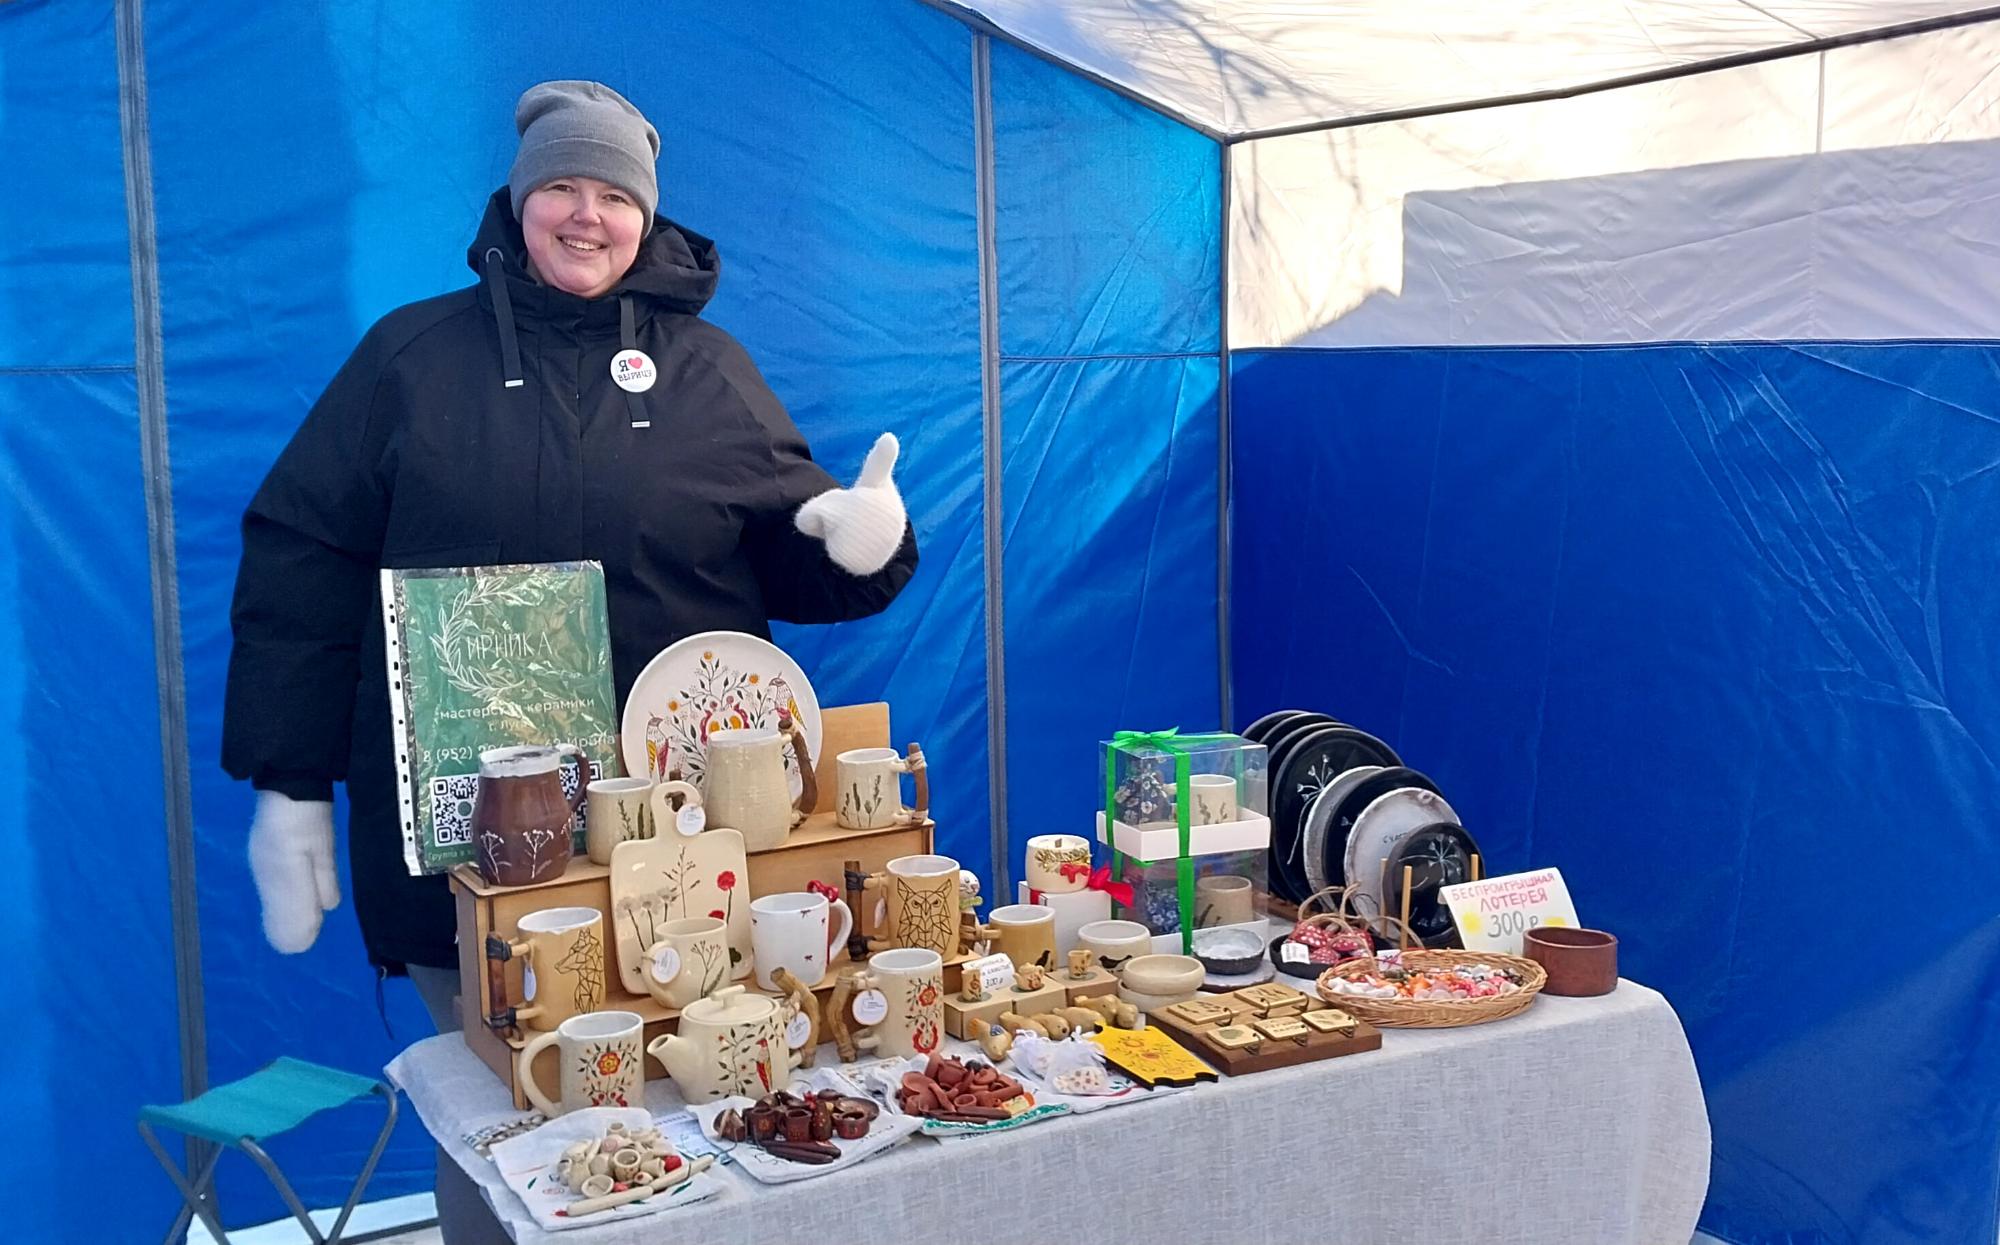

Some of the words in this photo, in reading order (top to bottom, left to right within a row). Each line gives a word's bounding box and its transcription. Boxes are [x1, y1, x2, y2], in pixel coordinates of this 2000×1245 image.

[618, 359, 629, 372] Я
[466, 631, 552, 660] ИРНИКА
[527, 698, 594, 713] керамики
[437, 745, 473, 763] (952)
[1451, 873, 1555, 902] БЕСПРОИГРЫШНАЯ
[1480, 888, 1547, 912] ЛОТЕРЕЯ
[1488, 910, 1525, 938] 300
